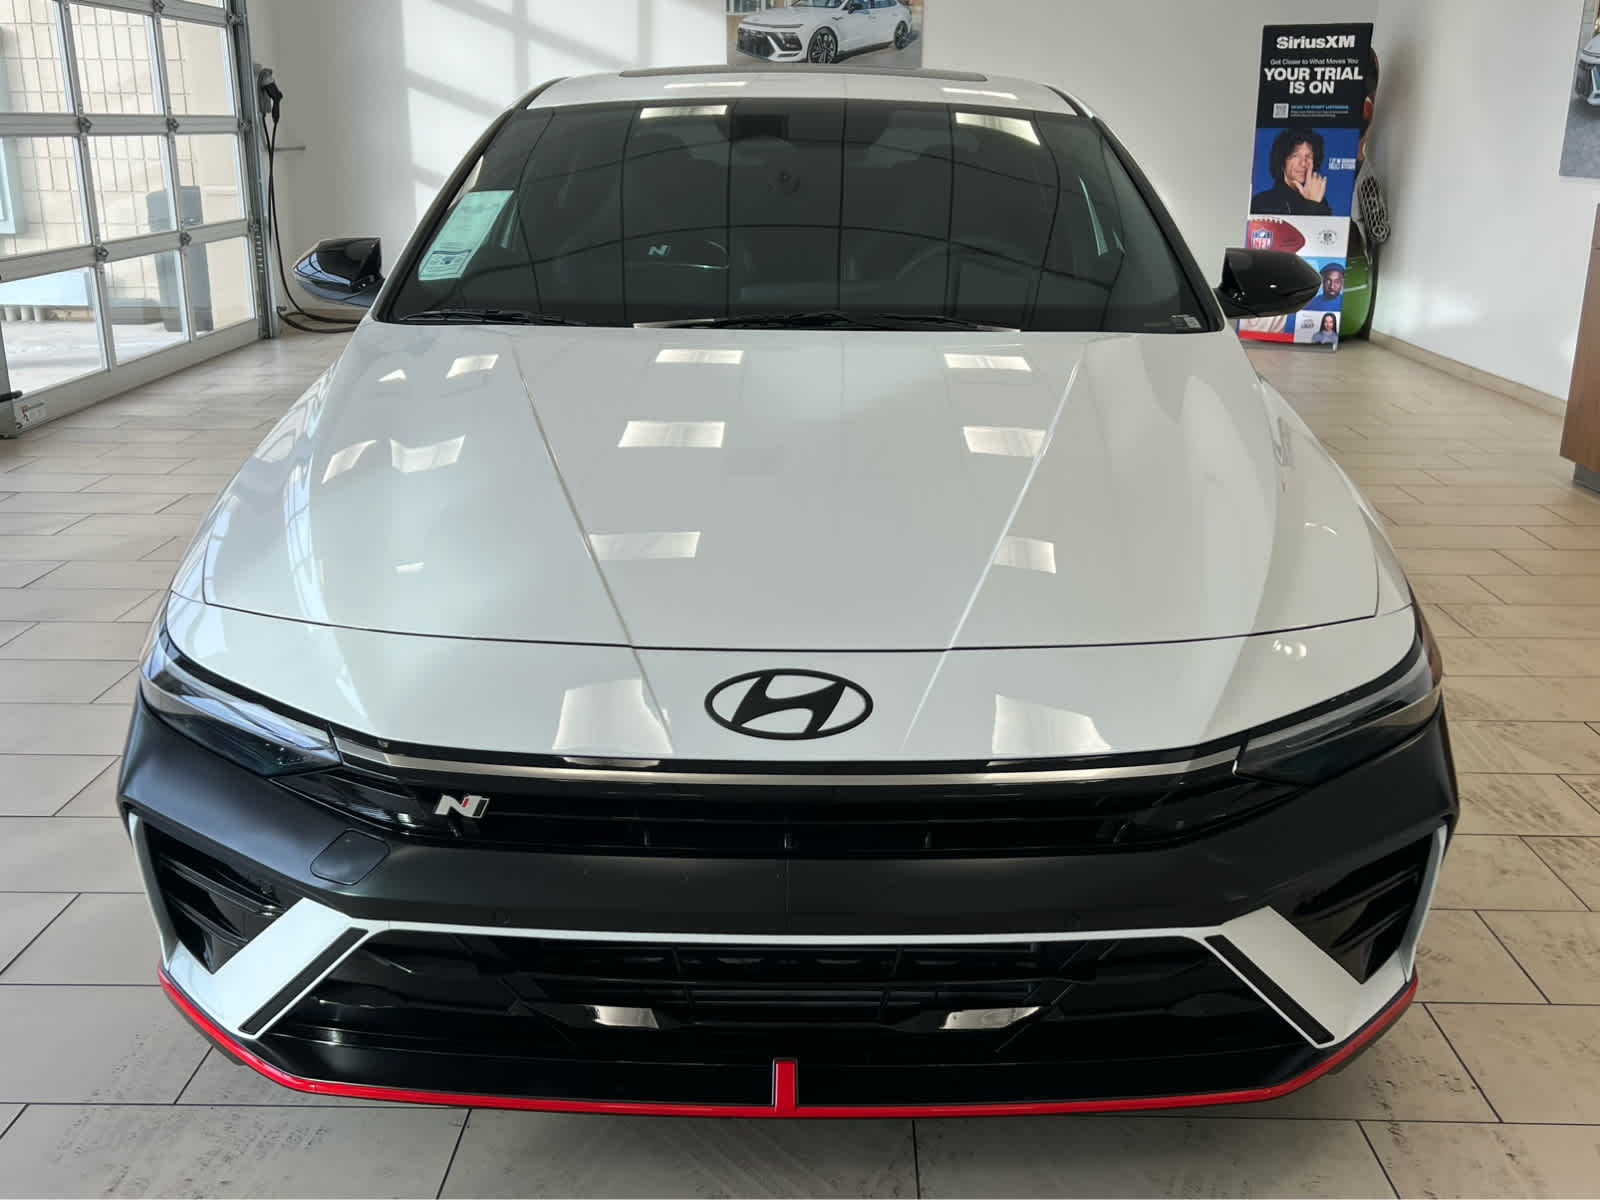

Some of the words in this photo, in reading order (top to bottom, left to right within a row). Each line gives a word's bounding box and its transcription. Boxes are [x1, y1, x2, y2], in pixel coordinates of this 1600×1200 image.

[1276, 35, 1356, 49] SiriusXM
[1347, 57, 1359, 65] You
[1264, 67, 1310, 81] YOUR
[1314, 67, 1364, 81] TRIAL
[1289, 81, 1305, 94] IS
[1308, 81, 1335, 94] ON
